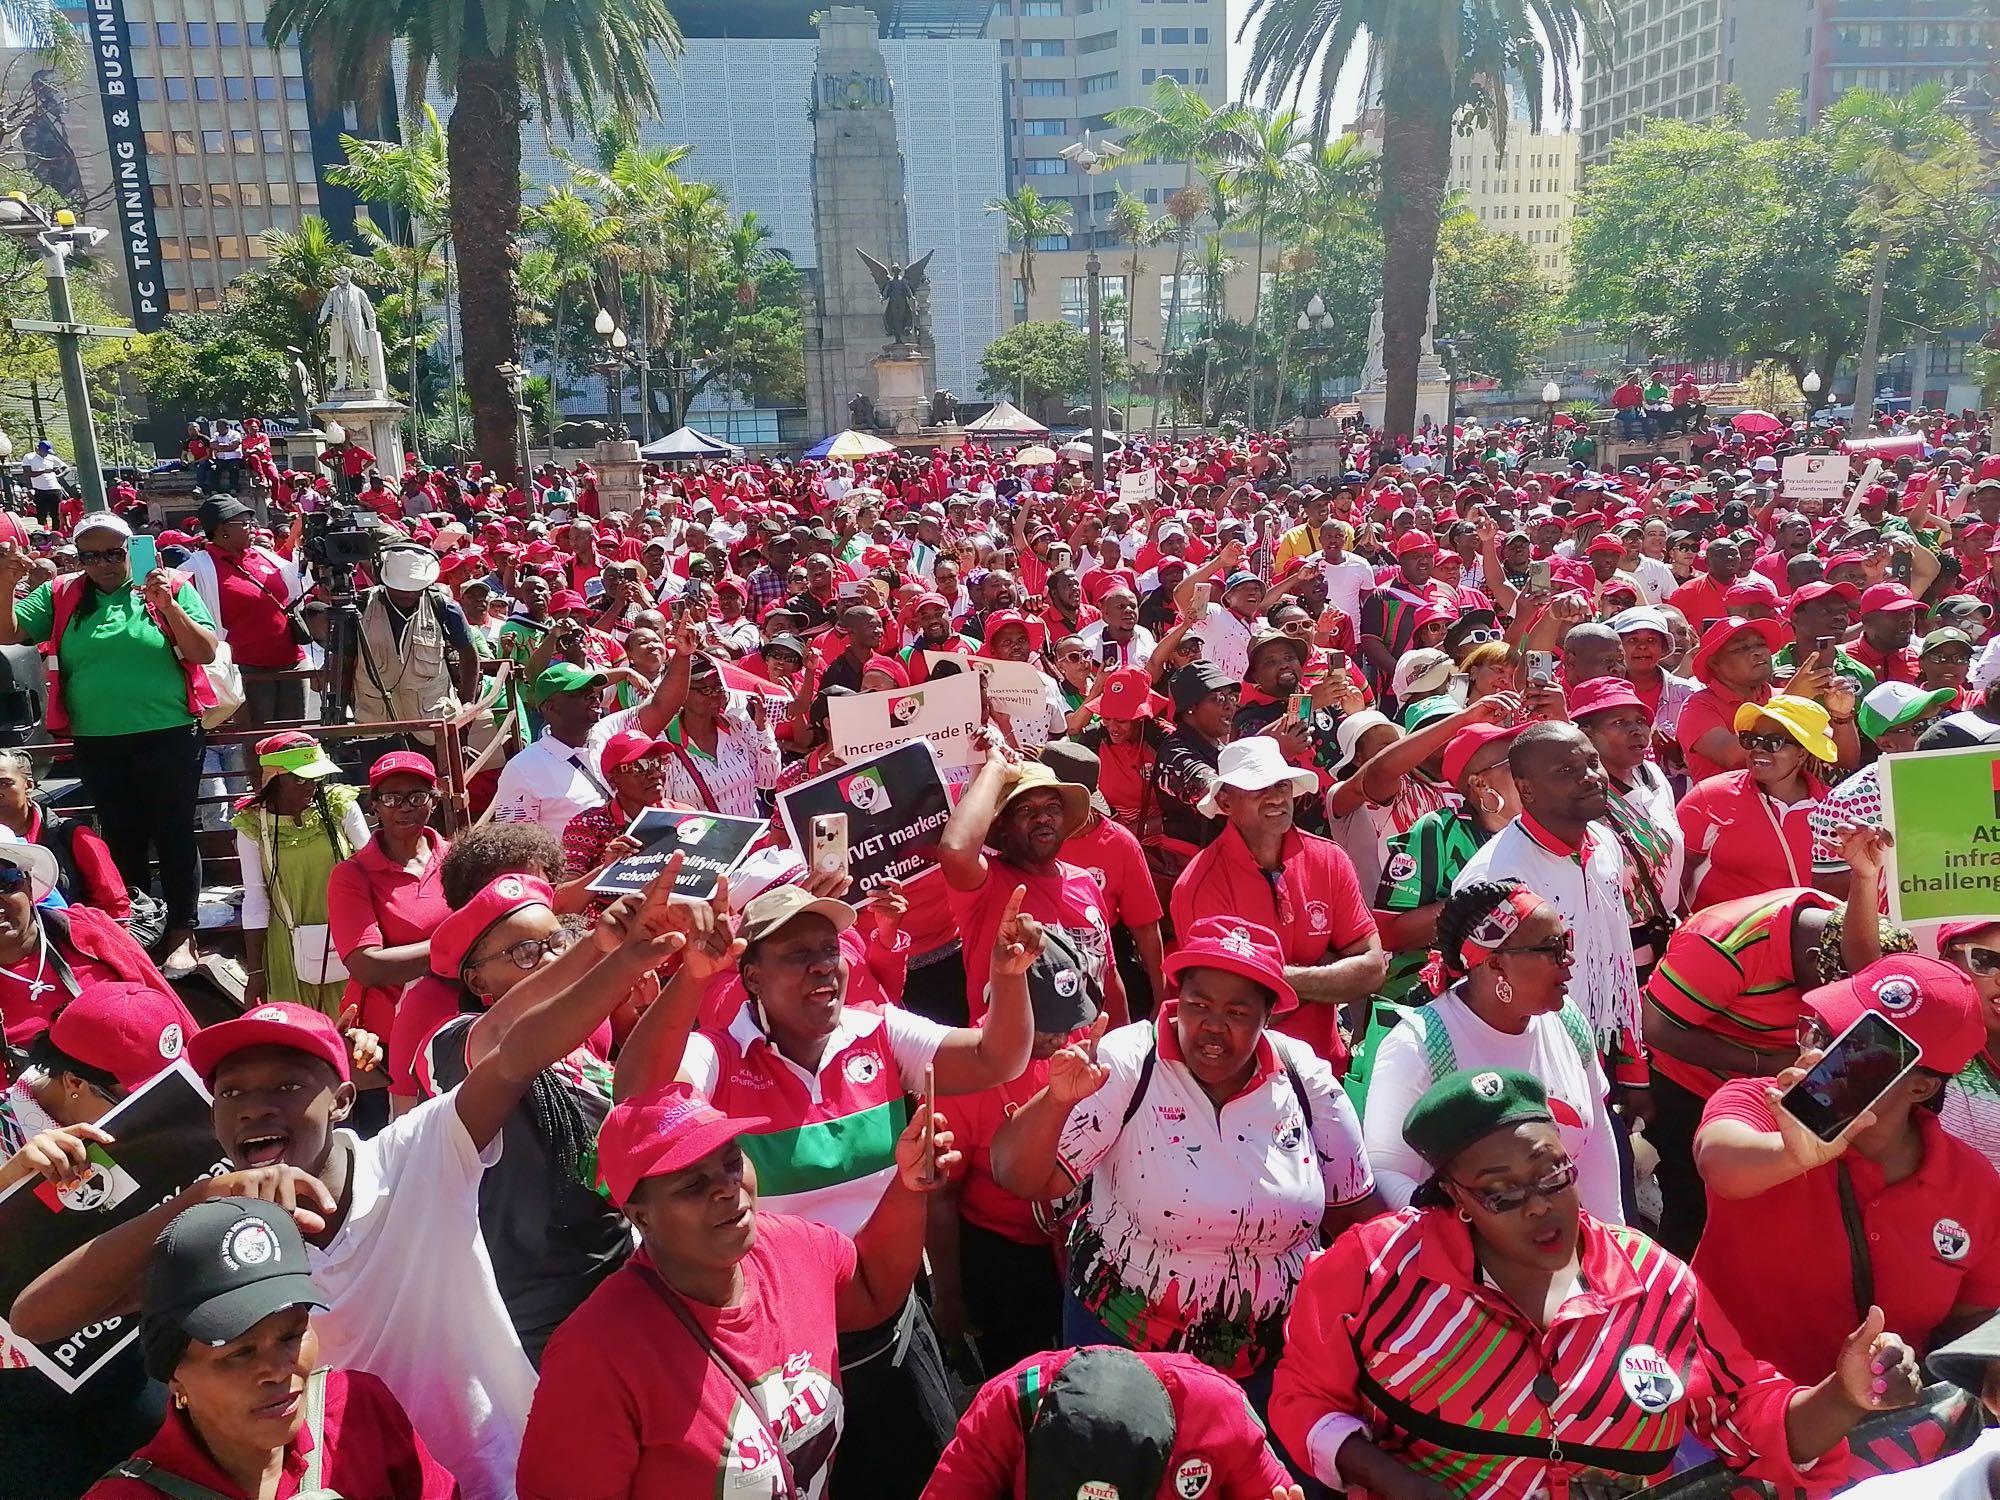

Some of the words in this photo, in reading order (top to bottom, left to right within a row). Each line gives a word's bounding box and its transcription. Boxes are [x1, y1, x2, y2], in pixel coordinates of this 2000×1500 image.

[112, 109, 130, 127] &
[116, 141, 152, 269] TRAINING
[138, 281, 158, 314] PC
[917, 725, 960, 742] rade
[965, 722, 974, 735] R
[889, 809, 949, 846] markers
[664, 853, 730, 874] qalifying
[860, 873, 883, 891] on
[1625, 1357, 1667, 1375] SADTU
[1180, 1465, 1208, 1478] SADTU
[1083, 1484, 1116, 1499] SADTU
